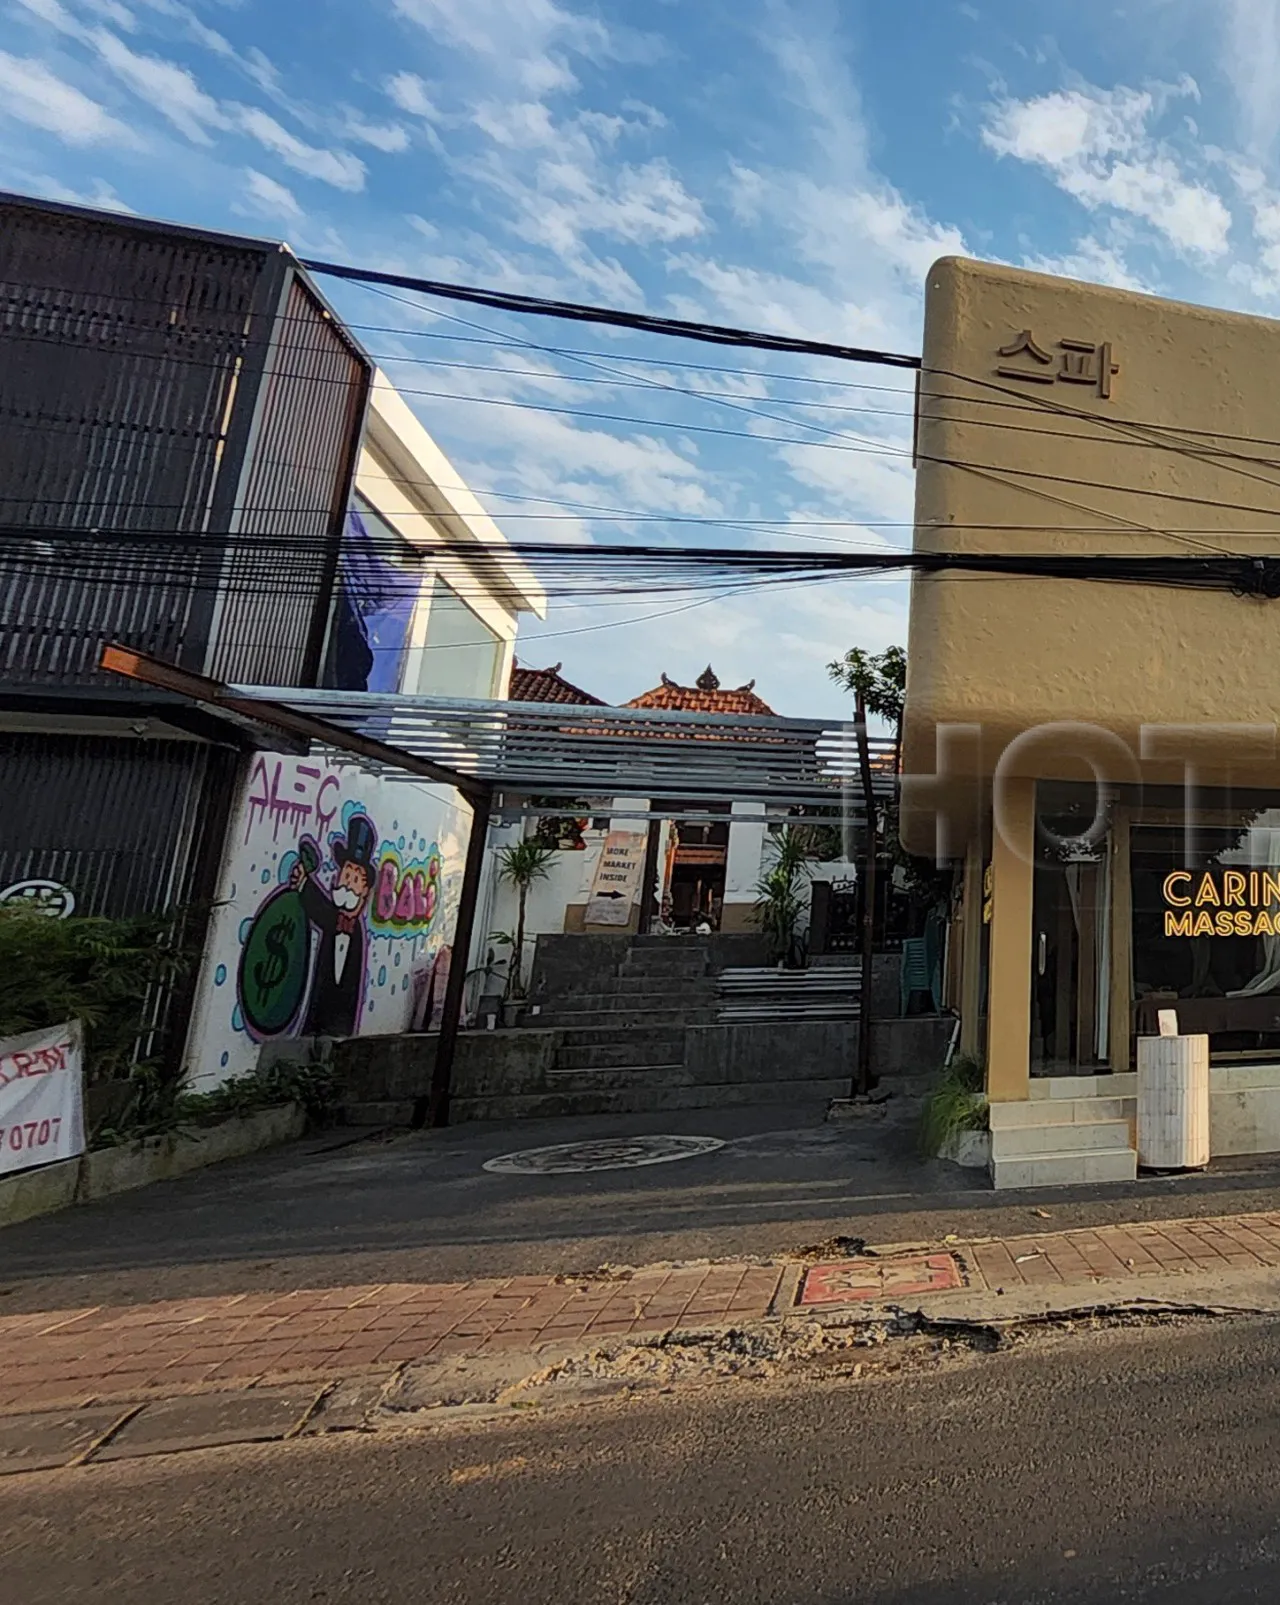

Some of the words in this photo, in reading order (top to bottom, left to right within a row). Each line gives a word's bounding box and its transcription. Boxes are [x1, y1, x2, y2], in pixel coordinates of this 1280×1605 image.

[994, 330, 1120, 399] 스파
[606, 847, 629, 856] MORE
[603, 861, 636, 870] MARKET
[600, 872, 628, 882] INSIDE
[9, 1117, 62, 1151] 0707
